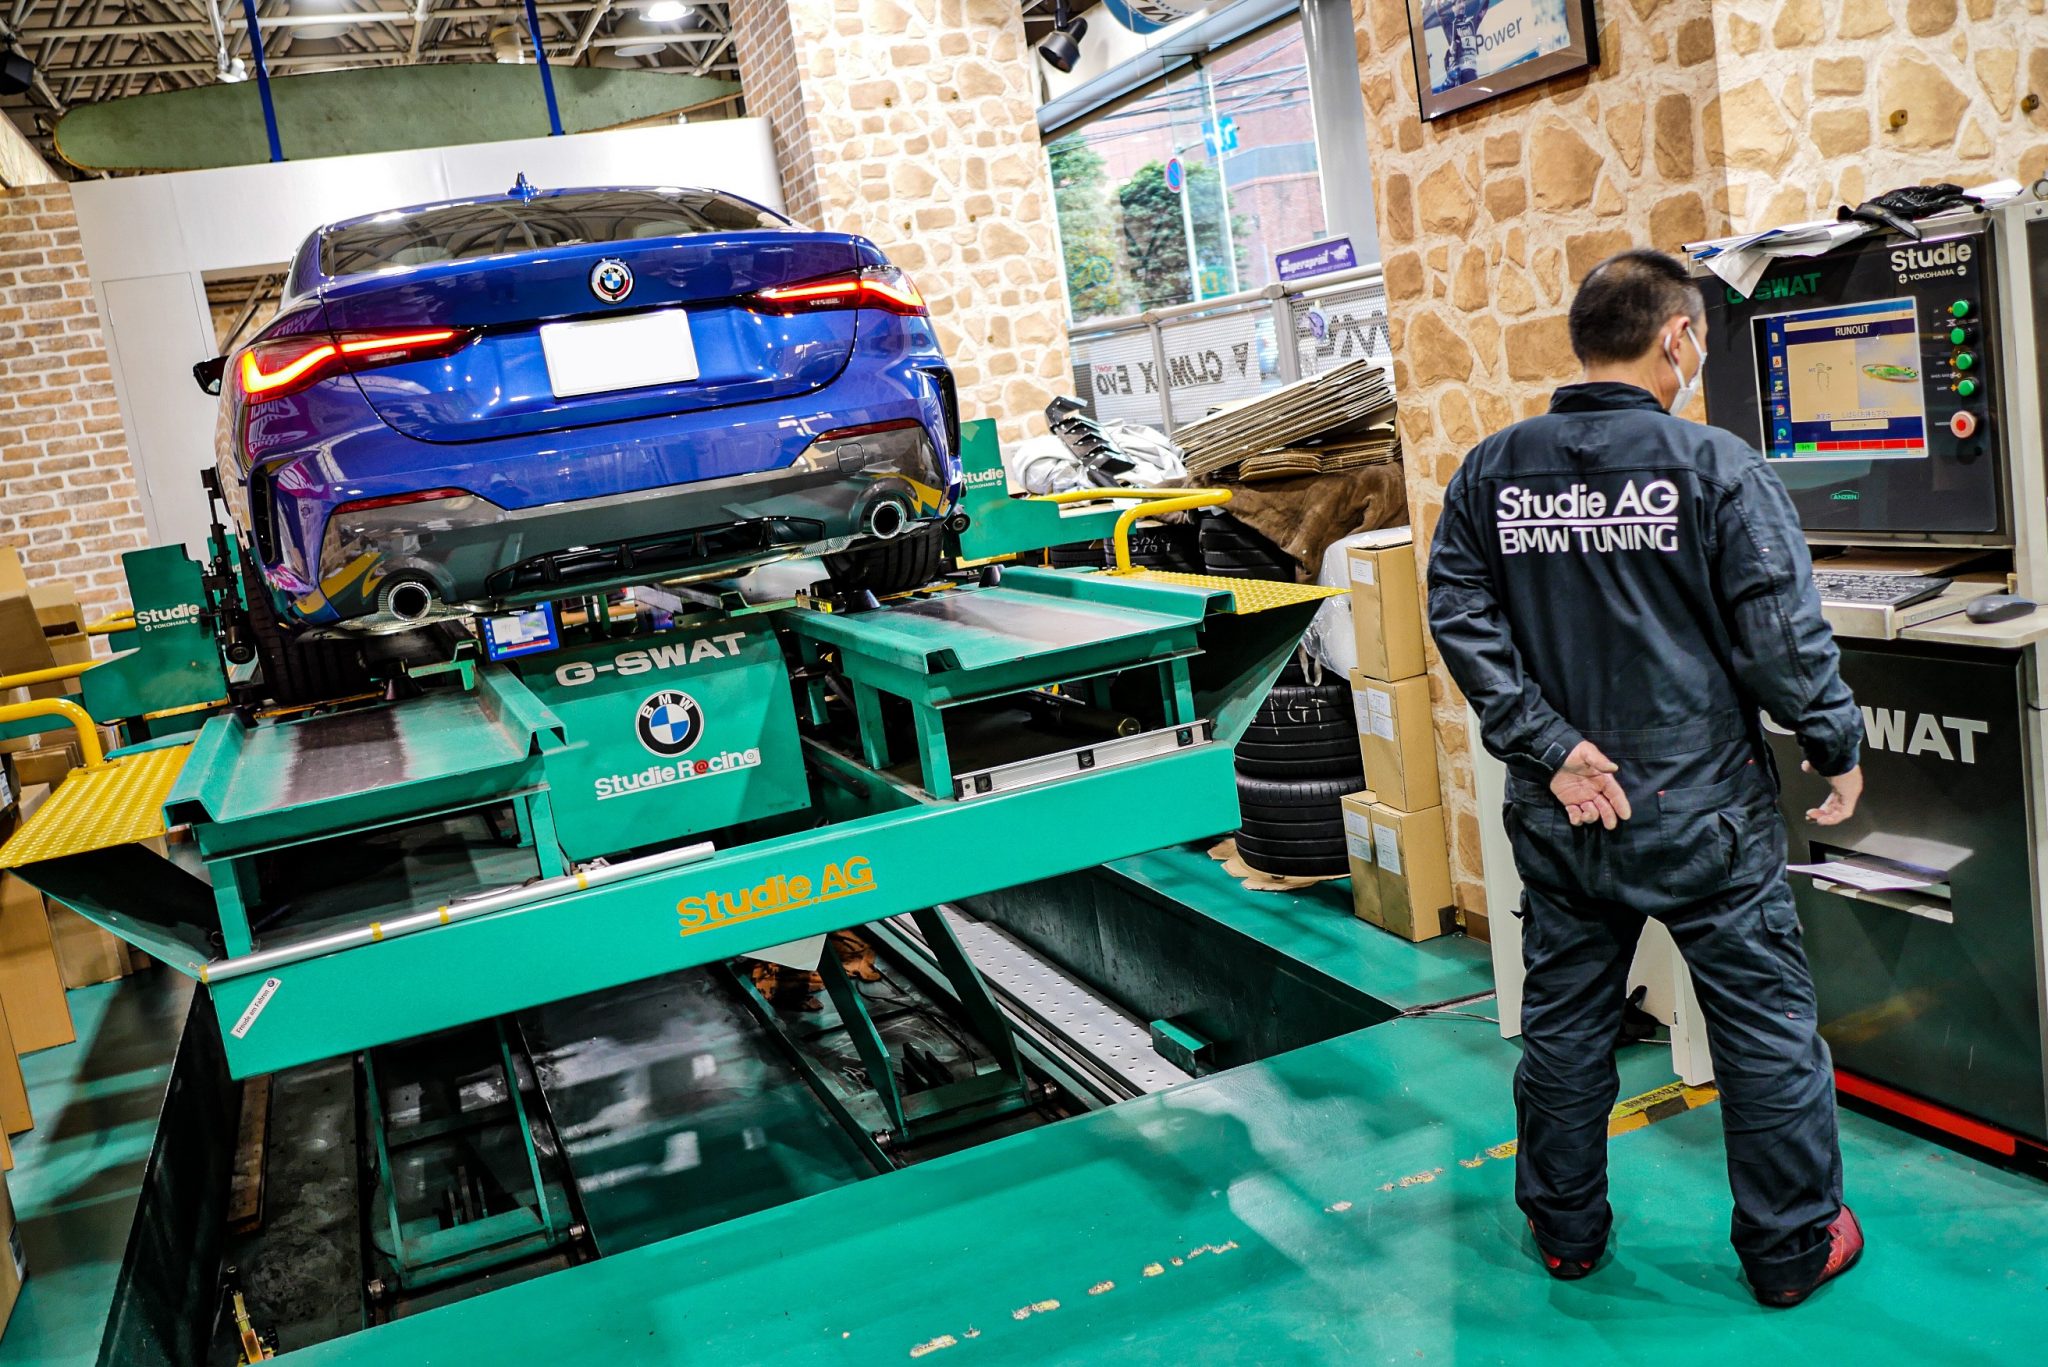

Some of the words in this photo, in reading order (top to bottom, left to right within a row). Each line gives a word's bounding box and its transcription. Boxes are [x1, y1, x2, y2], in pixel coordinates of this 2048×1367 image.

[1464, 37, 1471, 47] 2
[1475, 16, 1522, 55] Power
[1890, 243, 1971, 272] Studie
[1726, 272, 1822, 304] GSWAT
[1909, 268, 1955, 282] YOKOHAMA
[1835, 324, 1870, 337] RUNOUT
[1497, 484, 1607, 520] Studie
[1613, 479, 1679, 516] AG
[1499, 526, 1569, 555] BMW
[1571, 524, 1678, 553] TUNING
[136, 603, 200, 624] Studie
[153, 619, 189, 629] YOKOHAMA
[555, 631, 746, 687] G-SWAT
[641, 693, 694, 719] BMW
[594, 765, 676, 797] Studie
[676, 874, 812, 928] Studie
[820, 856, 874, 894] AG
[236, 1015, 251, 1033] Freude
